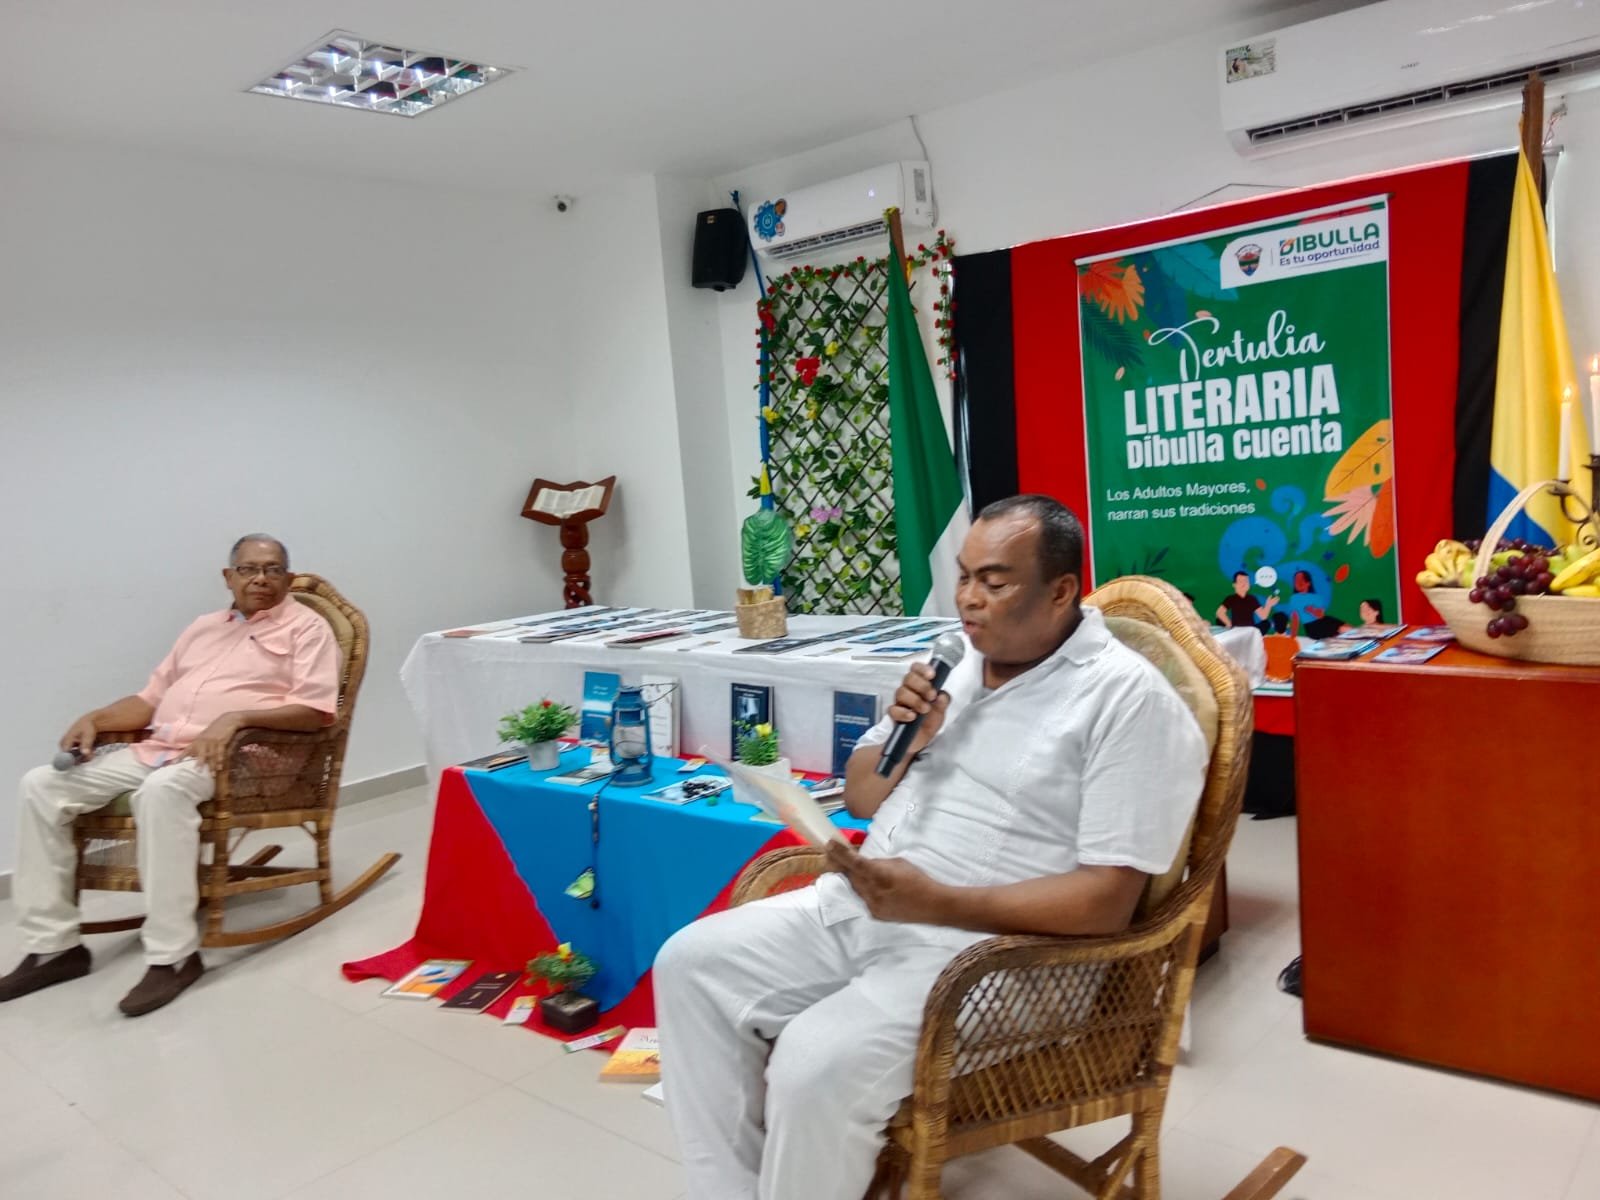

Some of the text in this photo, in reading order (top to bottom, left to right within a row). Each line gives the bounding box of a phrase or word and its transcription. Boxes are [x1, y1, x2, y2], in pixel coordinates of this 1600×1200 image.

[1279, 223, 1380, 257] DIBULLA
[1279, 240, 1380, 266] Es tu oportunidad
[1148, 309, 1326, 382] Tertulia
[1123, 364, 1341, 436] LITERARIA
[1126, 432, 1225, 469] Dibulla
[1107, 480, 1251, 502] Los Adultos Mayores,
[1107, 502, 1256, 521] narran sus tradiciones
